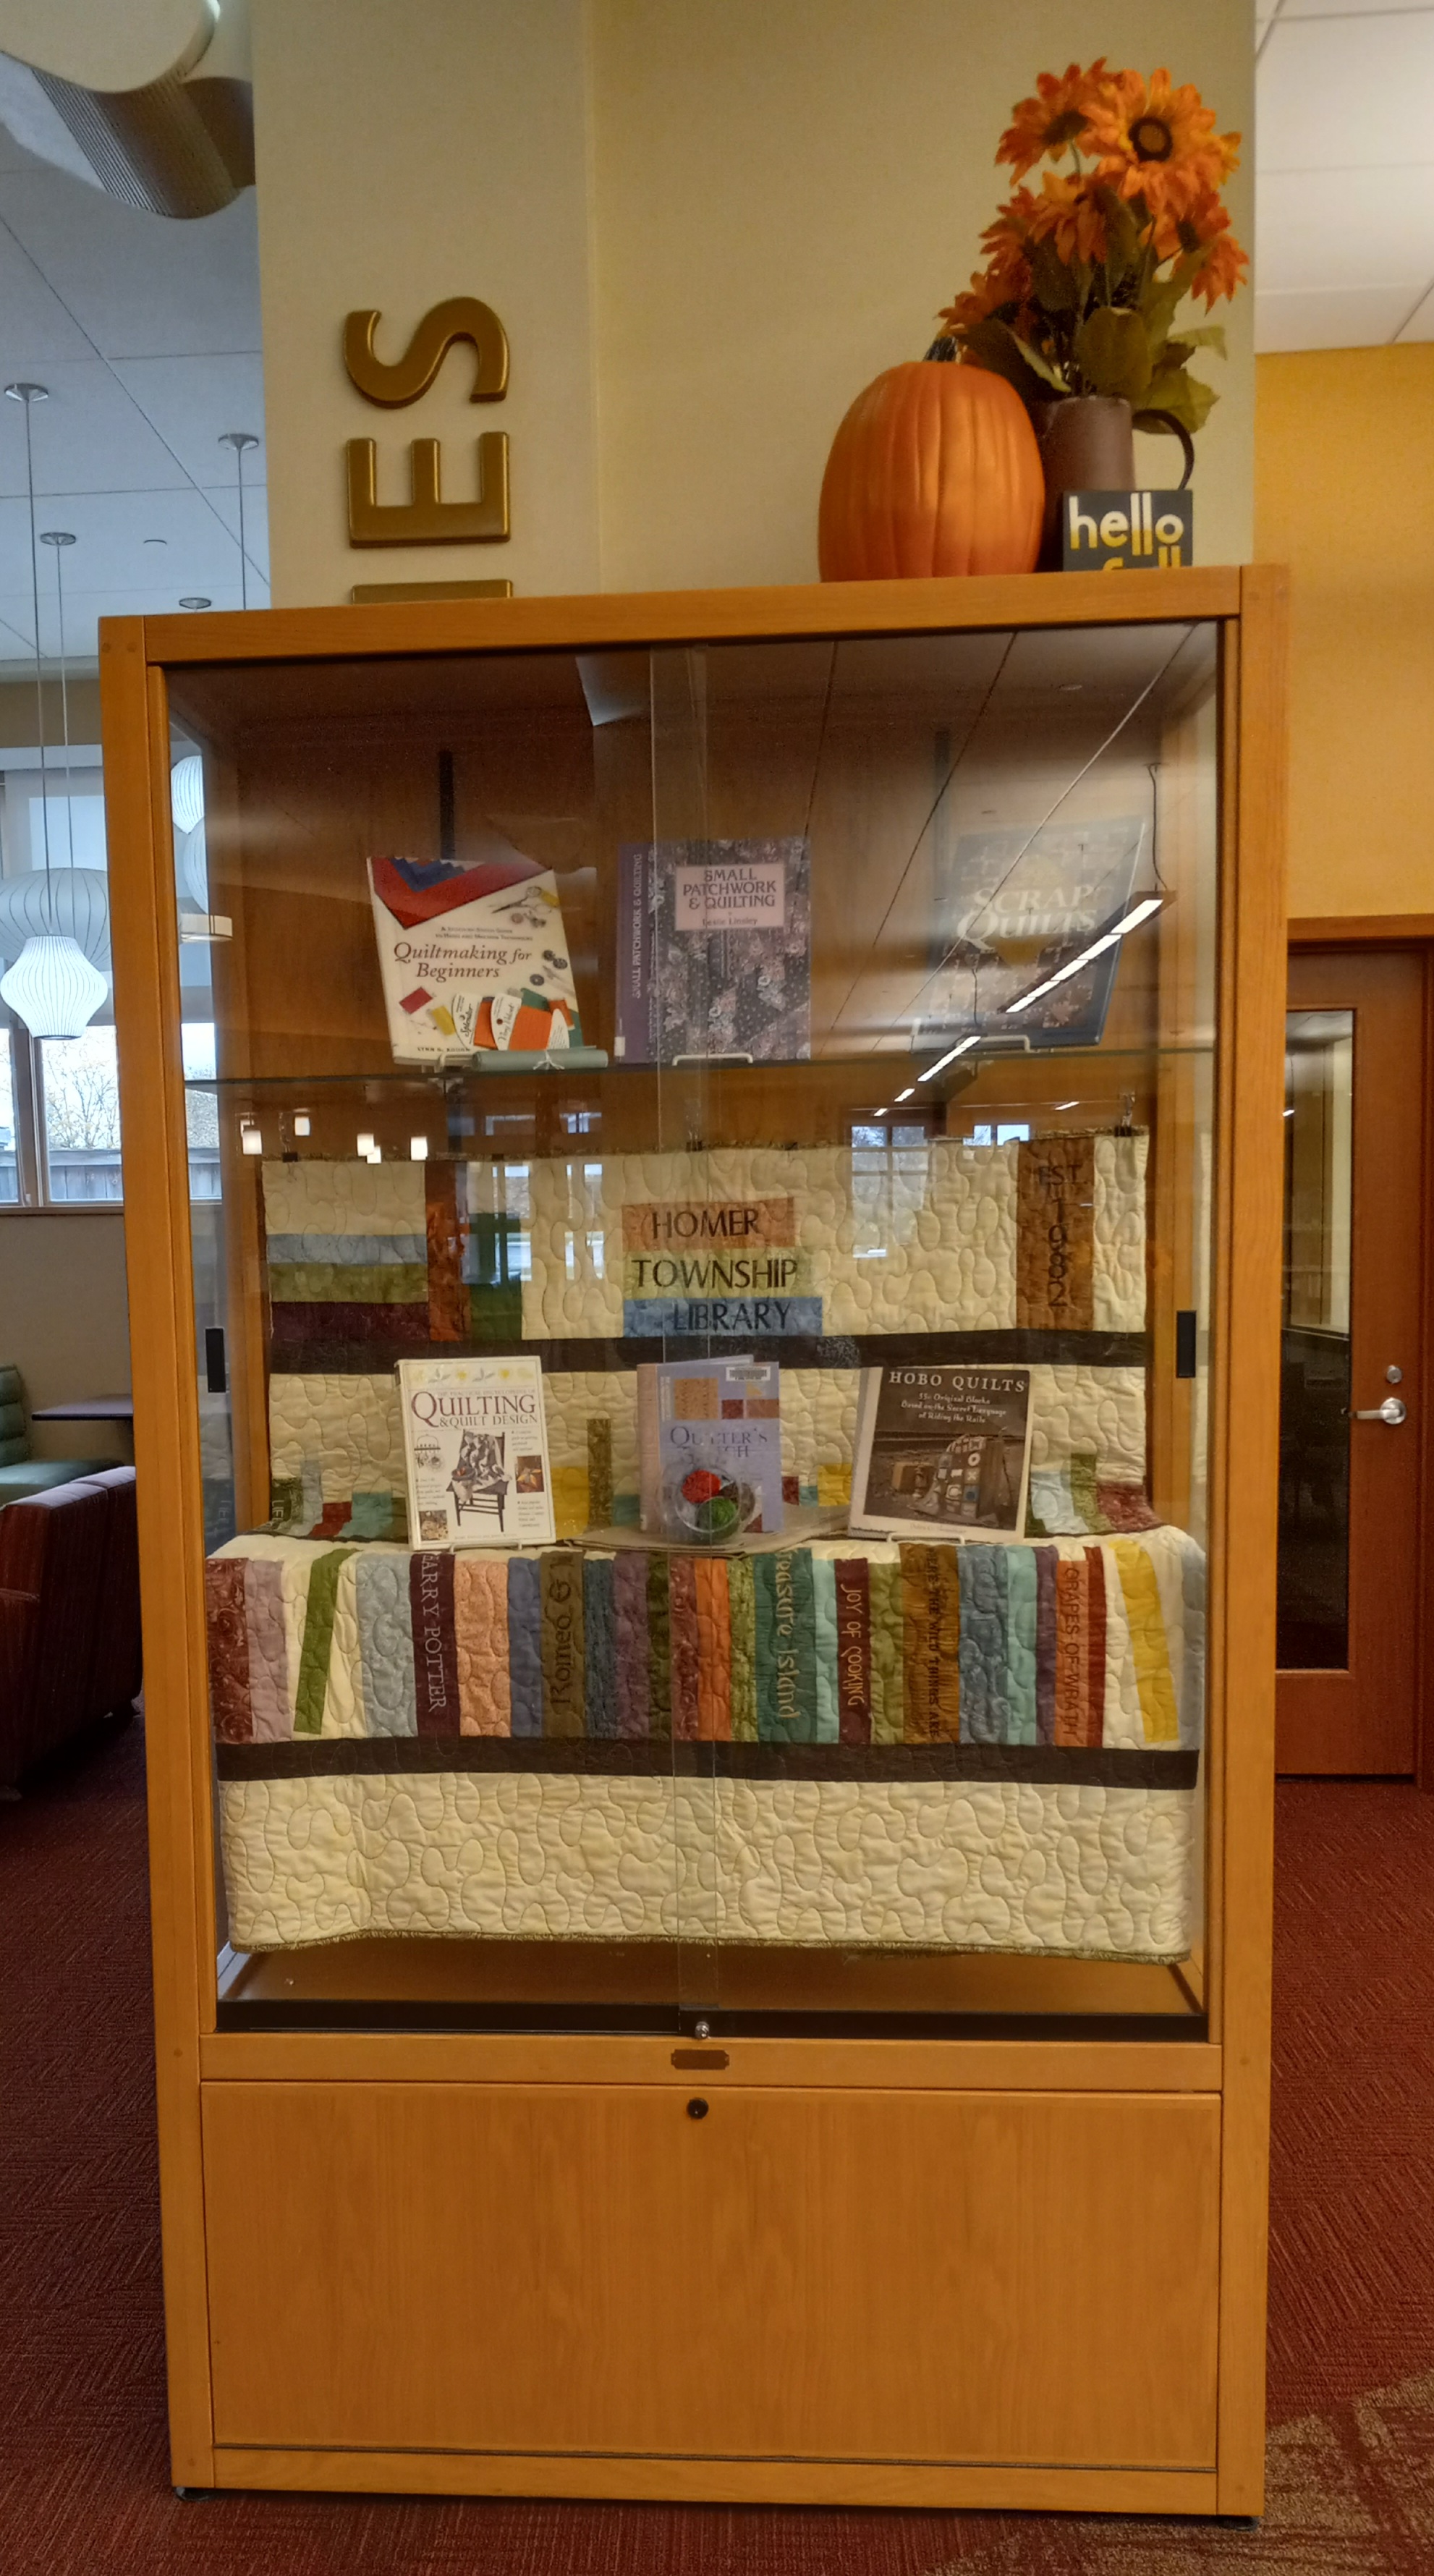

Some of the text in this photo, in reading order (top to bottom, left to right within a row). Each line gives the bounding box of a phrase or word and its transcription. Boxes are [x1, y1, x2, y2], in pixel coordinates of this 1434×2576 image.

[1069, 491, 1184, 556] hello
[633, 854, 642, 897] QUILTING
[683, 881, 776, 897] PATCHWORK
[705, 868, 758, 882] SMALL
[689, 894, 776, 910] & QUILTING
[974, 884, 1094, 914] SCRAP
[632, 908, 642, 966] PATCHWORK
[394, 941, 533, 966] Quiltmaking for
[416, 962, 501, 983] Beginners
[652, 1208, 760, 1239] HOMER
[1049, 1198, 1069, 1307] 1982
[631, 1259, 798, 1289] TOWNSHIP
[674, 1301, 792, 1331] LIBRARY
[888, 1370, 1025, 1393] HOBO QUILTS
[410, 1390, 536, 1428] QUILTING
[901, 1399, 923, 1409] Based
[946, 1404, 971, 1412] Secret
[972, 1404, 1007, 1418] Language
[933, 1393, 965, 1403] Original
[965, 1395, 990, 1405] Blocks
[492, 1415, 538, 1426] DESIGN
[928, 1412, 952, 1424] Riding
[953, 1413, 964, 1423] the
[966, 1414, 986, 1424] Rails
[928, 1588, 941, 1615] THE
[776, 1550, 801, 1719] reasure Island
[840, 1583, 865, 1706] JOY OF COOKING
[928, 1621, 940, 1651] WILD
[549, 1614, 573, 1704] Romeo
[1063, 1567, 1080, 1736] GRAPES OF WRATH
[423, 1625, 447, 1713] POTTER
[928, 1656, 940, 1706] THINGS
[928, 1711, 940, 1737] ARE
